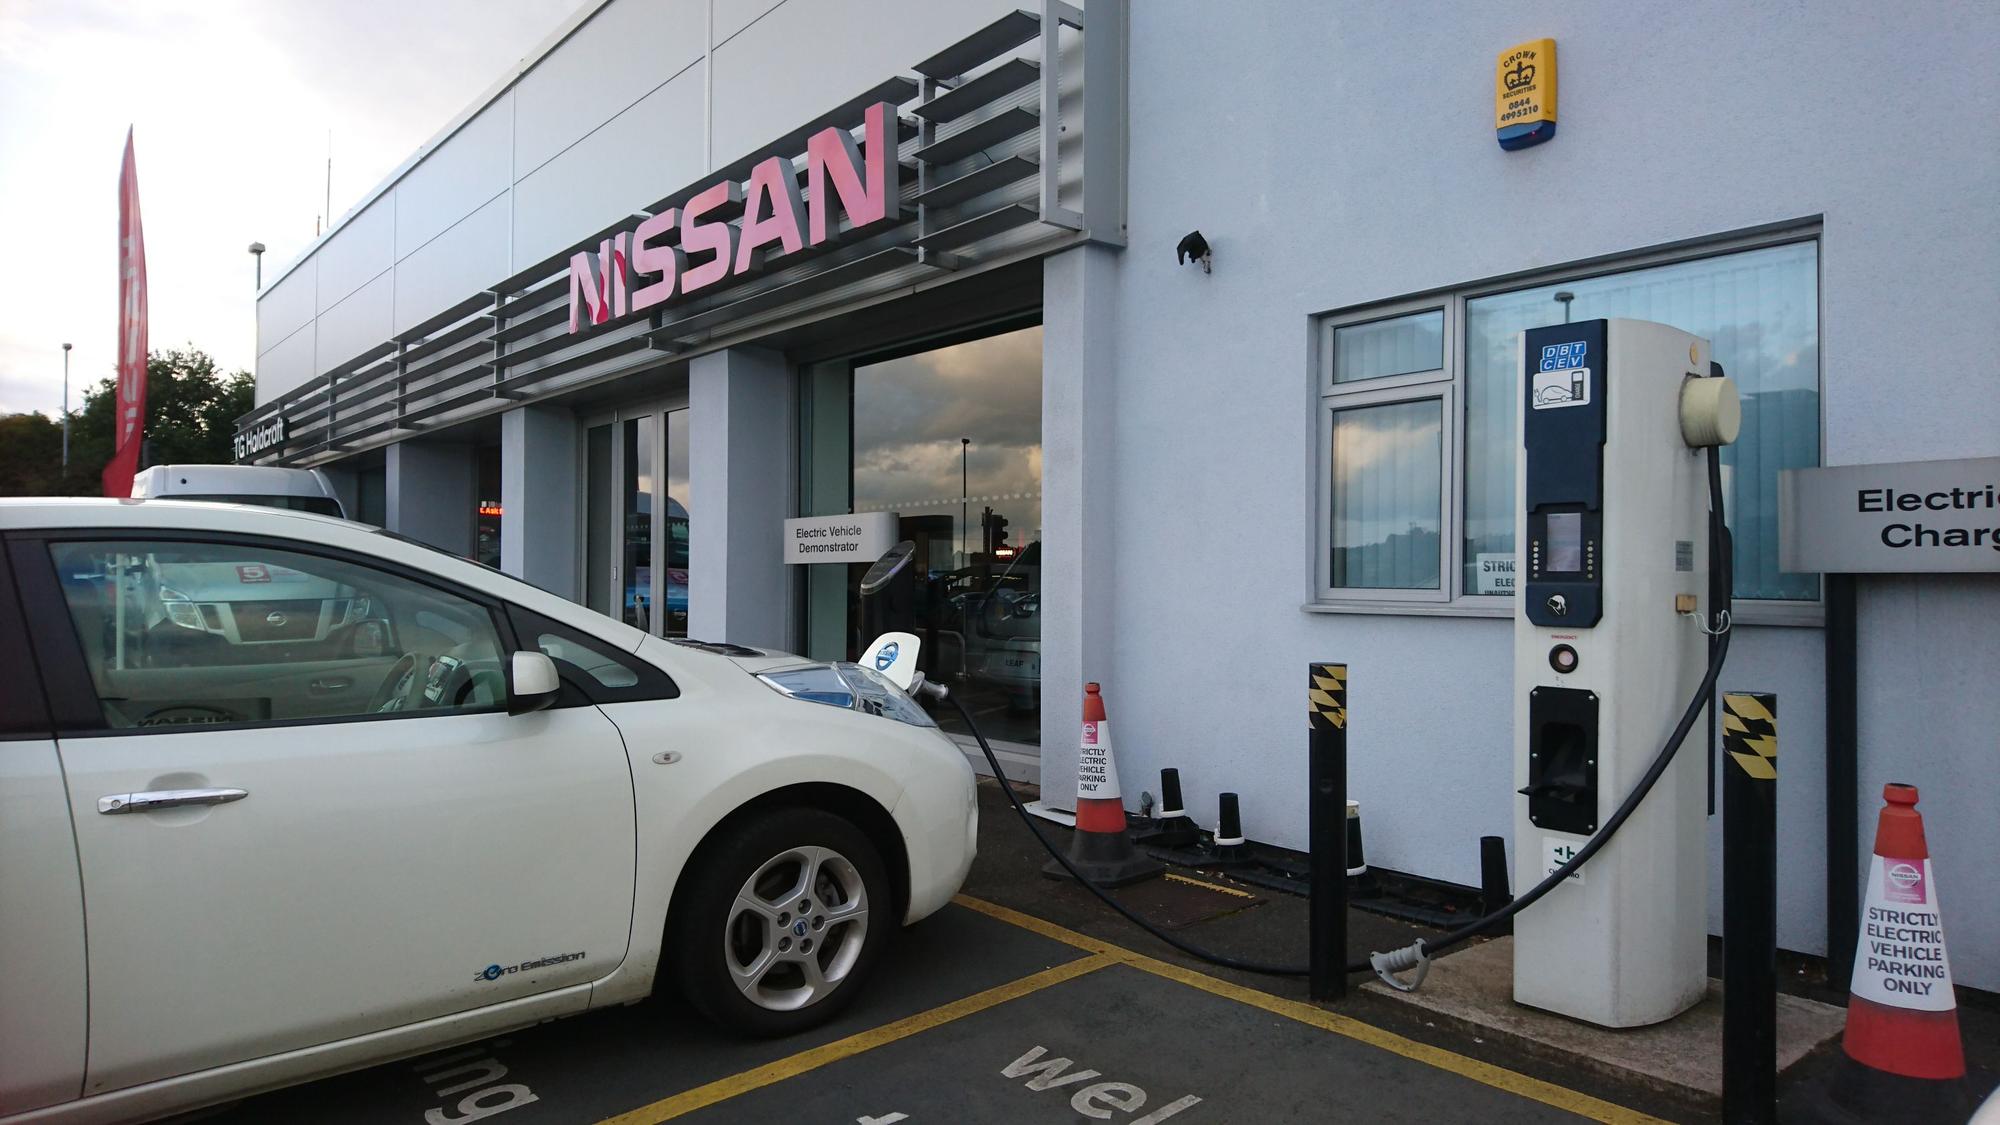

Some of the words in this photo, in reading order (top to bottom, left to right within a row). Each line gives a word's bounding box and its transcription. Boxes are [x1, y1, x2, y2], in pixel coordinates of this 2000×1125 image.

[1503, 50, 1537, 68] CROWN
[1502, 84, 1537, 100] SECURITIES
[1508, 97, 1531, 110] 0844
[569, 101, 891, 334] NISSAN
[1546, 343, 1583, 357] DBT
[1543, 356, 1581, 369] CEV
[233, 434, 245, 460] TG
[1858, 484, 2000, 513] Electri
[796, 528, 827, 539] Electric
[829, 524, 862, 537] Vehicle
[799, 541, 859, 553] Demonstrator
[1080, 783, 1098, 791] ONLY
[1868, 906, 1938, 927] STRICTLY
[1867, 923, 1941, 944] ELECTRIC
[1870, 940, 1942, 961] VEHICLE
[520, 951, 586, 972] Emission
[1868, 957, 1945, 979] PARKING
[1883, 977, 1933, 996] ONLY
